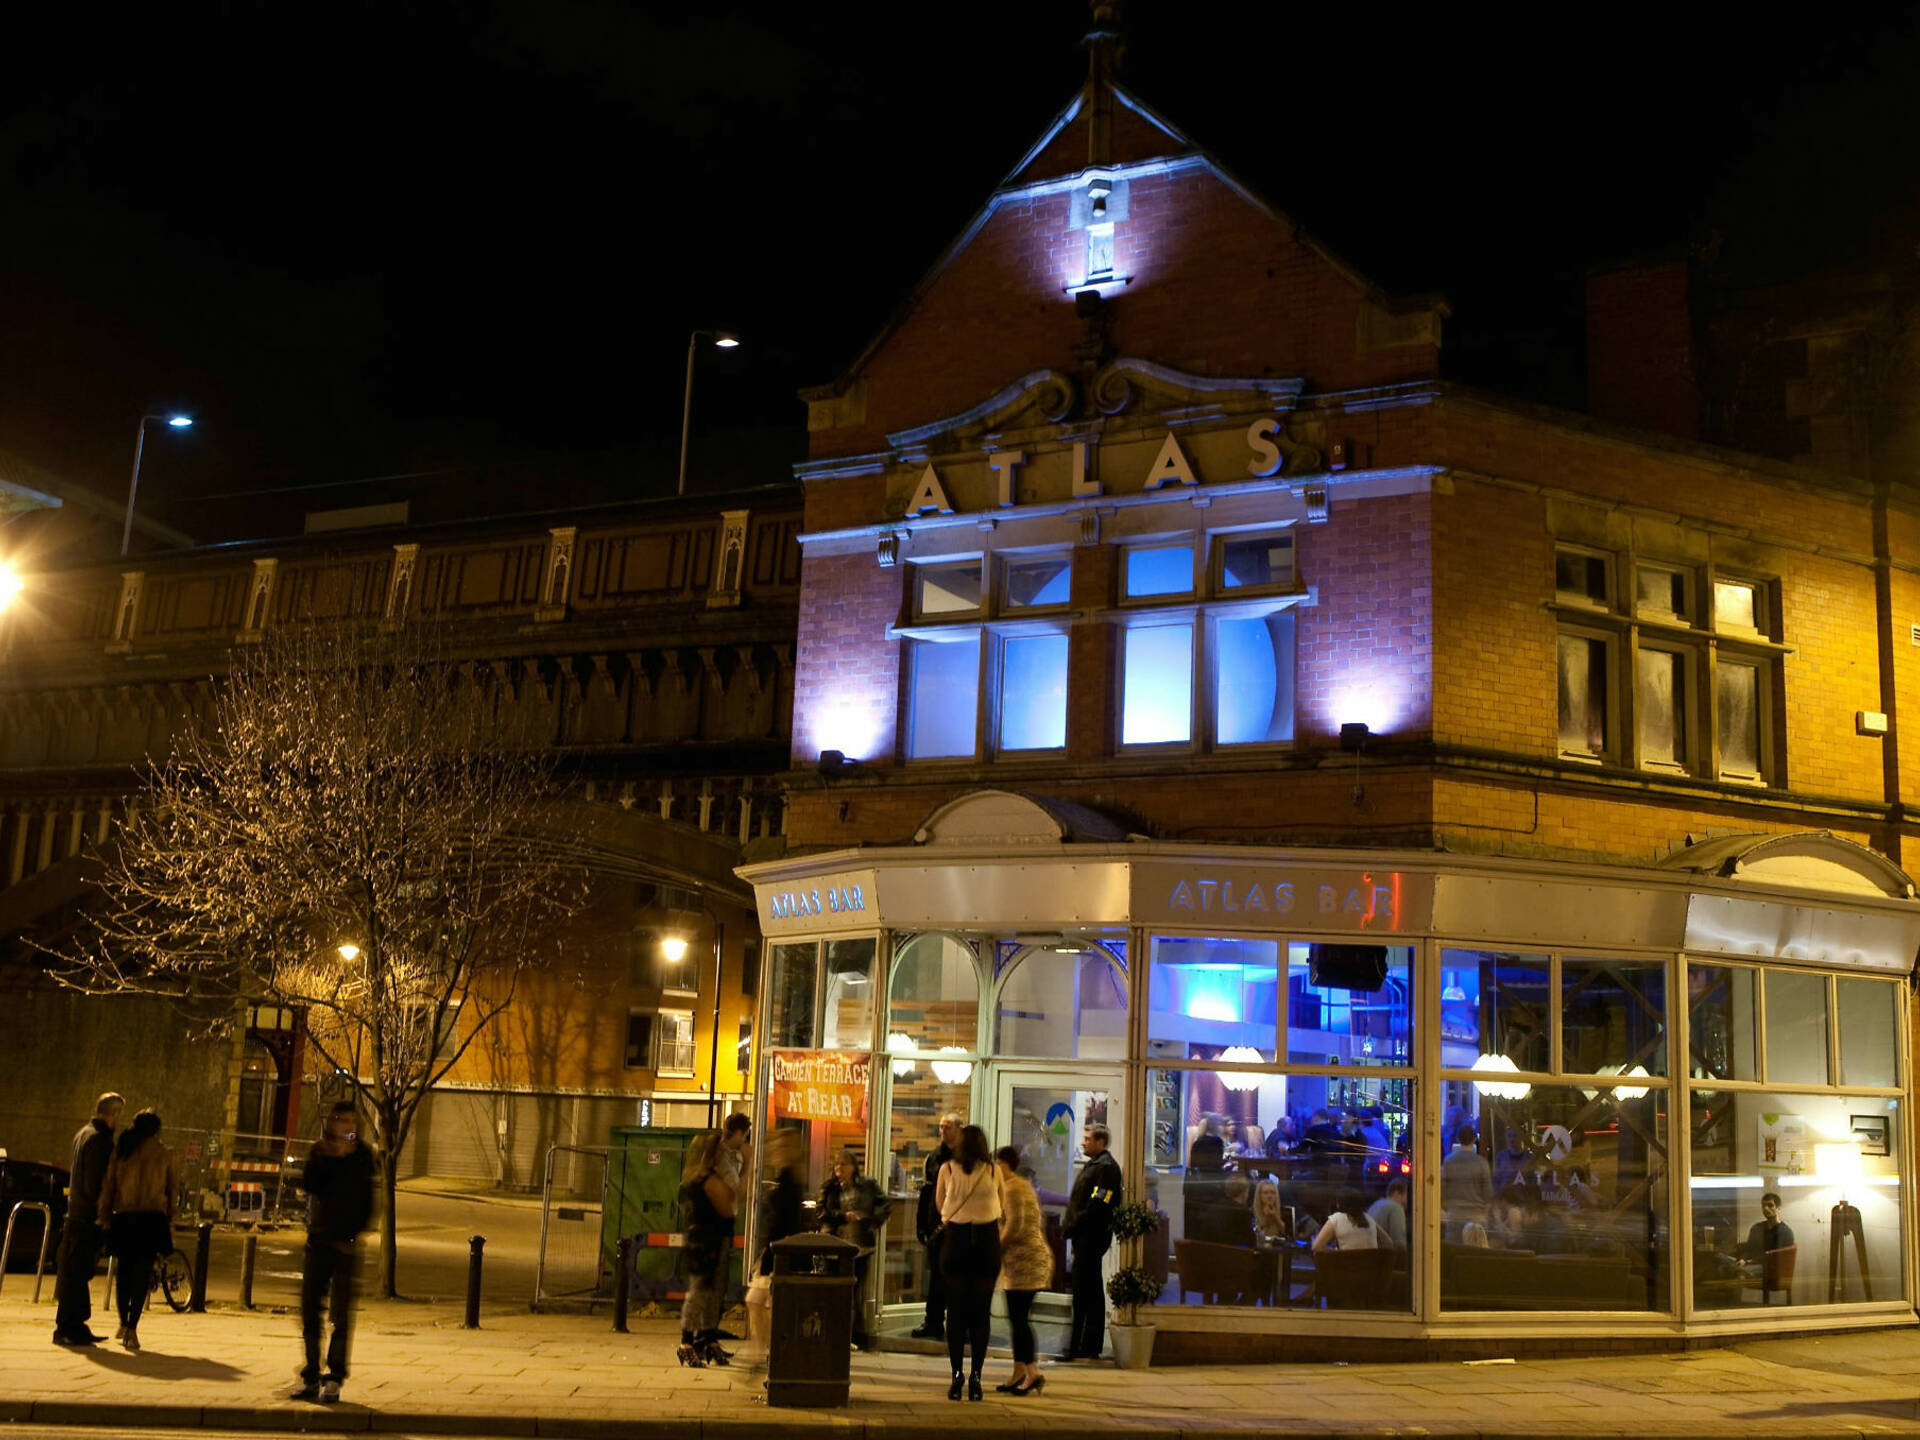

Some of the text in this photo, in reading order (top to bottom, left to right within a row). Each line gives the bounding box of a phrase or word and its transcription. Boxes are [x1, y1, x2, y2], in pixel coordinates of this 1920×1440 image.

[905, 418, 1283, 518] ATLAS
[771, 884, 866, 919] ATLAS BAR
[1168, 880, 1393, 917] ATLAS BAR
[774, 1054, 868, 1085] GARDEN TERRACE
[787, 1087, 853, 1117] AT REAR
[1512, 1170, 1600, 1187] ATLAS
